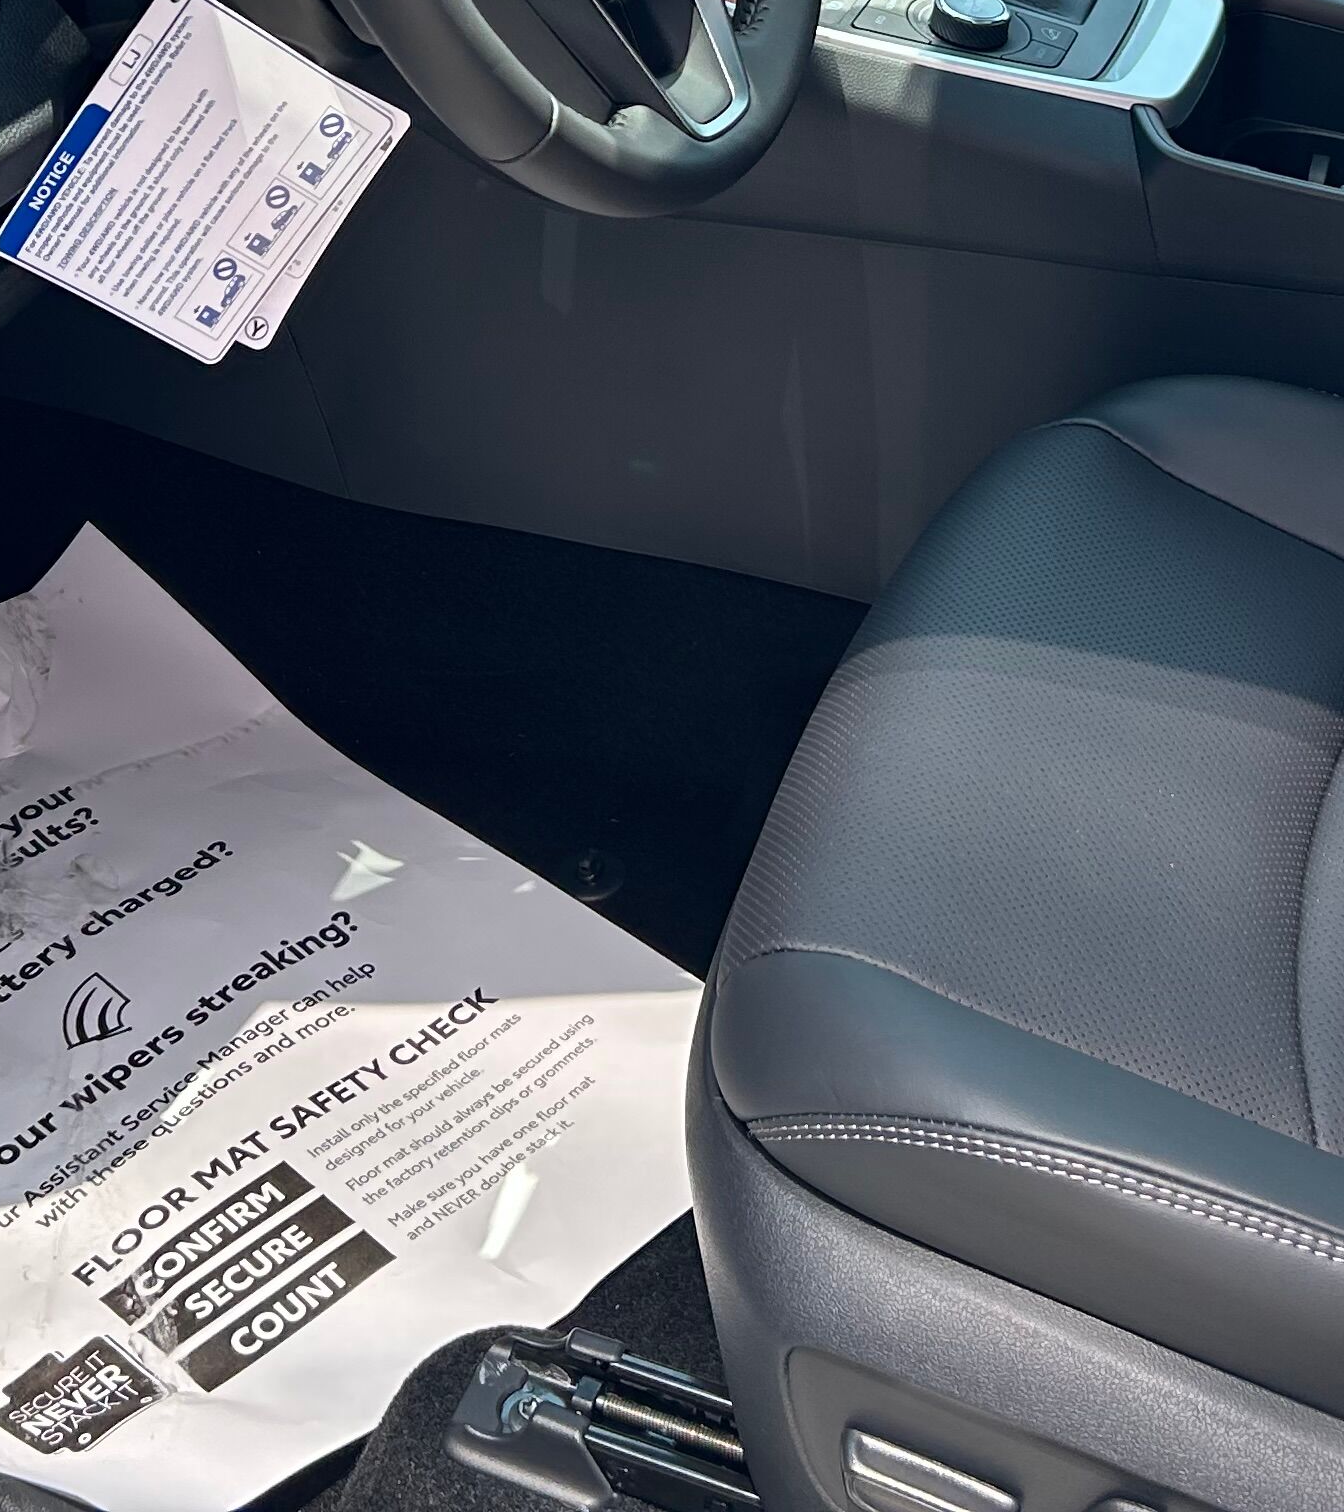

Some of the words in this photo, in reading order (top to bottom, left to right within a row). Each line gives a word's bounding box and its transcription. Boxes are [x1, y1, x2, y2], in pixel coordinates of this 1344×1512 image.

[122, 49, 142, 70] LJ
[27, 150, 76, 212] NOTICE
[75, 836, 233, 937] charged?
[54, 1014, 187, 1121] wipers
[182, 907, 361, 1027] streaking?
[18, 1121, 124, 1208] Assistant
[119, 1066, 200, 1133] Service
[197, 1006, 291, 1073] Manager
[289, 985, 329, 1015] can
[327, 958, 377, 995] help
[32, 1181, 88, 1230] with
[84, 1133, 150, 1189] these
[146, 1053, 253, 1142] questions
[249, 1028, 293, 1065] and
[293, 998, 356, 1043] more.
[69, 1177, 200, 1288] FLOOR
[194, 1129, 270, 1191] MAT
[270, 1056, 390, 1141] SAFETY
[383, 981, 496, 1069] CHECK
[306, 1126, 352, 1159] Install
[349, 1109, 380, 1133] only
[377, 1095, 403, 1116] the
[400, 1057, 460, 1104] specified
[456, 1035, 490, 1063] floor
[489, 1011, 522, 1040] mats
[323, 1126, 386, 1173] designed
[384, 1115, 405, 1134] for
[405, 1097, 436, 1124] your
[433, 1063, 485, 1103] vehicle.
[344, 1162, 382, 1192] Floor
[380, 1145, 409, 1169] mat
[407, 1117, 453, 1152] should
[451, 1088, 495, 1125] always
[491, 1074, 514, 1095] be
[509, 1037, 560, 1080] secured
[557, 1011, 594, 1042] using
[362, 1184, 388, 1206] the
[385, 1154, 433, 1191] factory
[431, 1115, 490, 1162] retention
[488, 1094, 520, 1121] clips
[517, 1083, 534, 1100] or
[531, 1033, 599, 1088] grommets.
[387, 1195, 427, 1228] Make
[426, 1177, 456, 1202] sure
[453, 1159, 482, 1187] you
[477, 1135, 513, 1165] have
[510, 1117, 538, 1141] one
[535, 1093, 568, 1122] floor
[566, 1073, 595, 1099] mat
[405, 1215, 435, 1241] and
[431, 1185, 479, 1222] NEVER
[477, 1149, 527, 1190] double
[524, 1125, 559, 1155] stack
[557, 1115, 574, 1131] it.
[128, 1176, 286, 1300] CONFIRM
[182, 1218, 313, 1321] SECURE
[226, 1260, 349, 1359] COUNT
[7, 1363, 90, 1426] SECURE
[83, 1350, 106, 1372] IT
[20, 1360, 128, 1438] NEVER
[38, 1391, 118, 1447] STACK
[113, 1378, 140, 1402] IT
